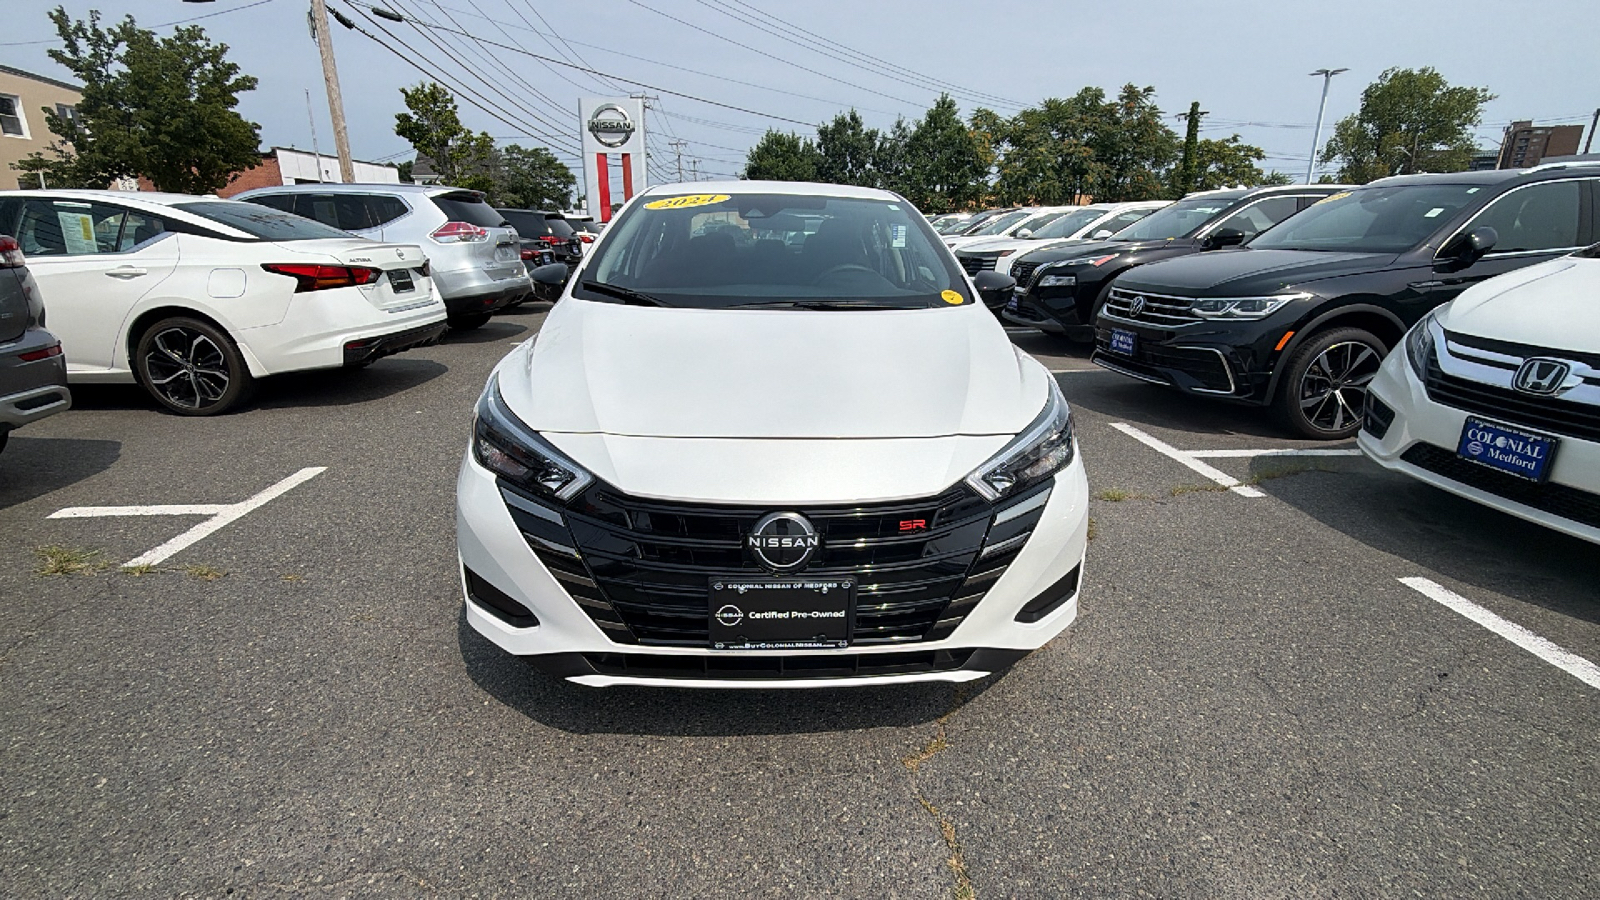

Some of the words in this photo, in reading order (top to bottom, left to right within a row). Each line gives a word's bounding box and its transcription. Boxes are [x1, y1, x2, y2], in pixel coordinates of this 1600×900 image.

[591, 121, 631, 129] NISSAN
[1467, 428, 1543, 459] COLONIAL
[1487, 448, 1536, 470] Medford
[899, 519, 927, 530] SR
[749, 536, 818, 548] NISSAN
[748, 611, 790, 619] Certified
[791, 610, 846, 619] Pre-Owned
